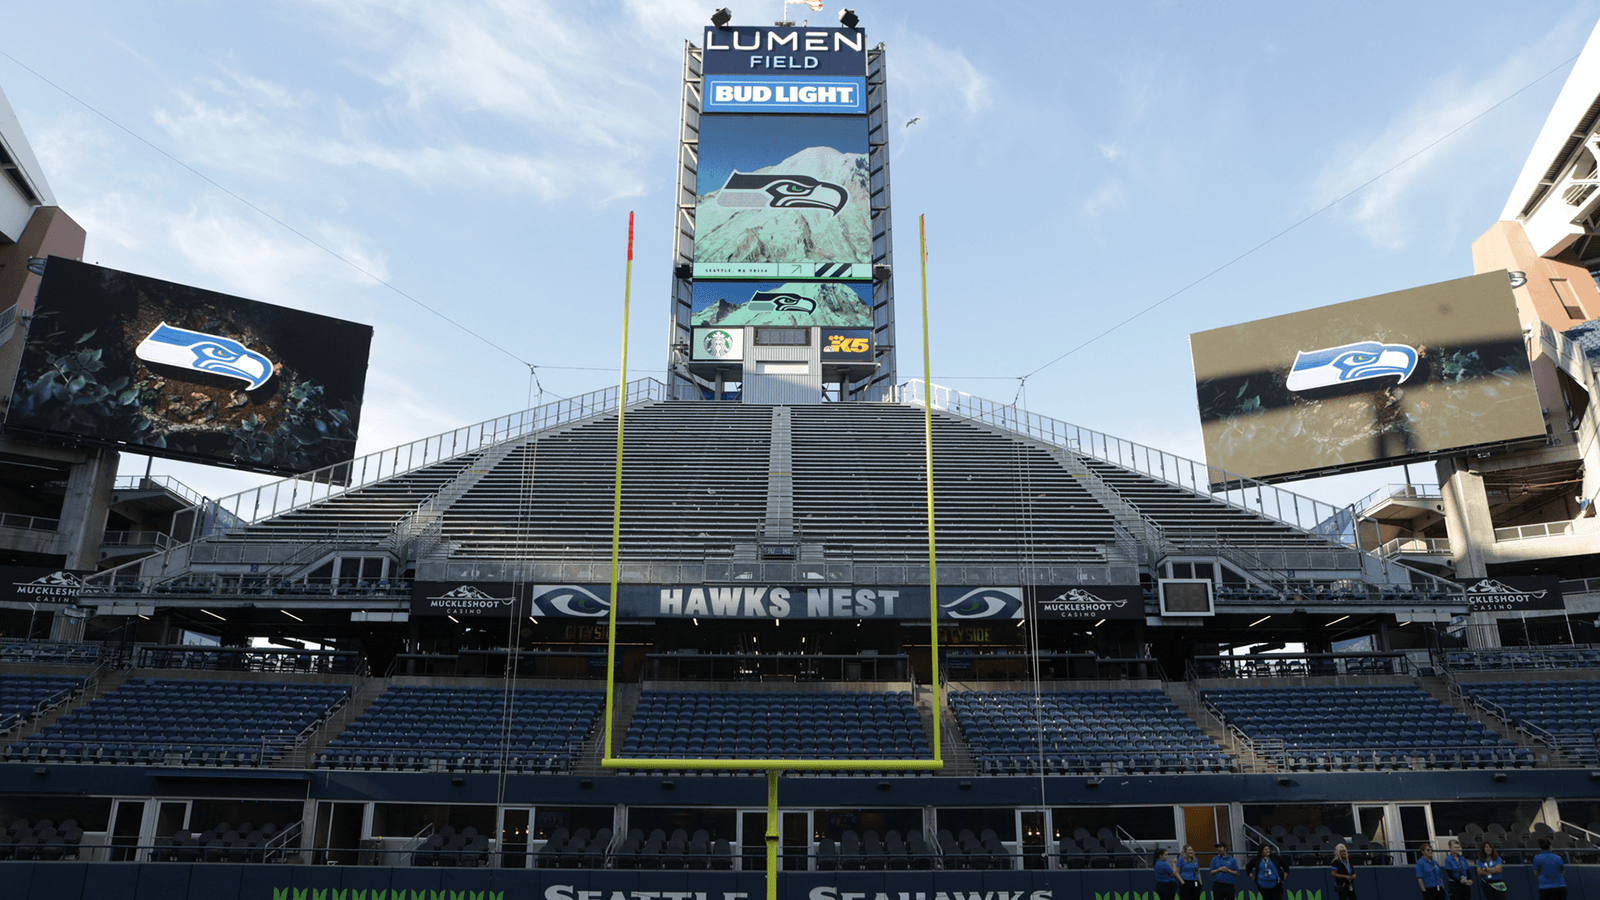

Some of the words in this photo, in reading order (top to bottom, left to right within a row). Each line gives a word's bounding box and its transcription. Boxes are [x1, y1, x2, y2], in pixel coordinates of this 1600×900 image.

[707, 31, 862, 52] LUMEN
[750, 55, 819, 69] FIELD
[715, 85, 772, 102] BUD
[430, 600, 500, 608] MUCKLESHOOT
[659, 587, 791, 618] HAWKS
[807, 588, 900, 618] NEST
[1453, 595, 1530, 604] CKLESHOOT
[1044, 603, 1112, 611] MUCKLESHOOT
